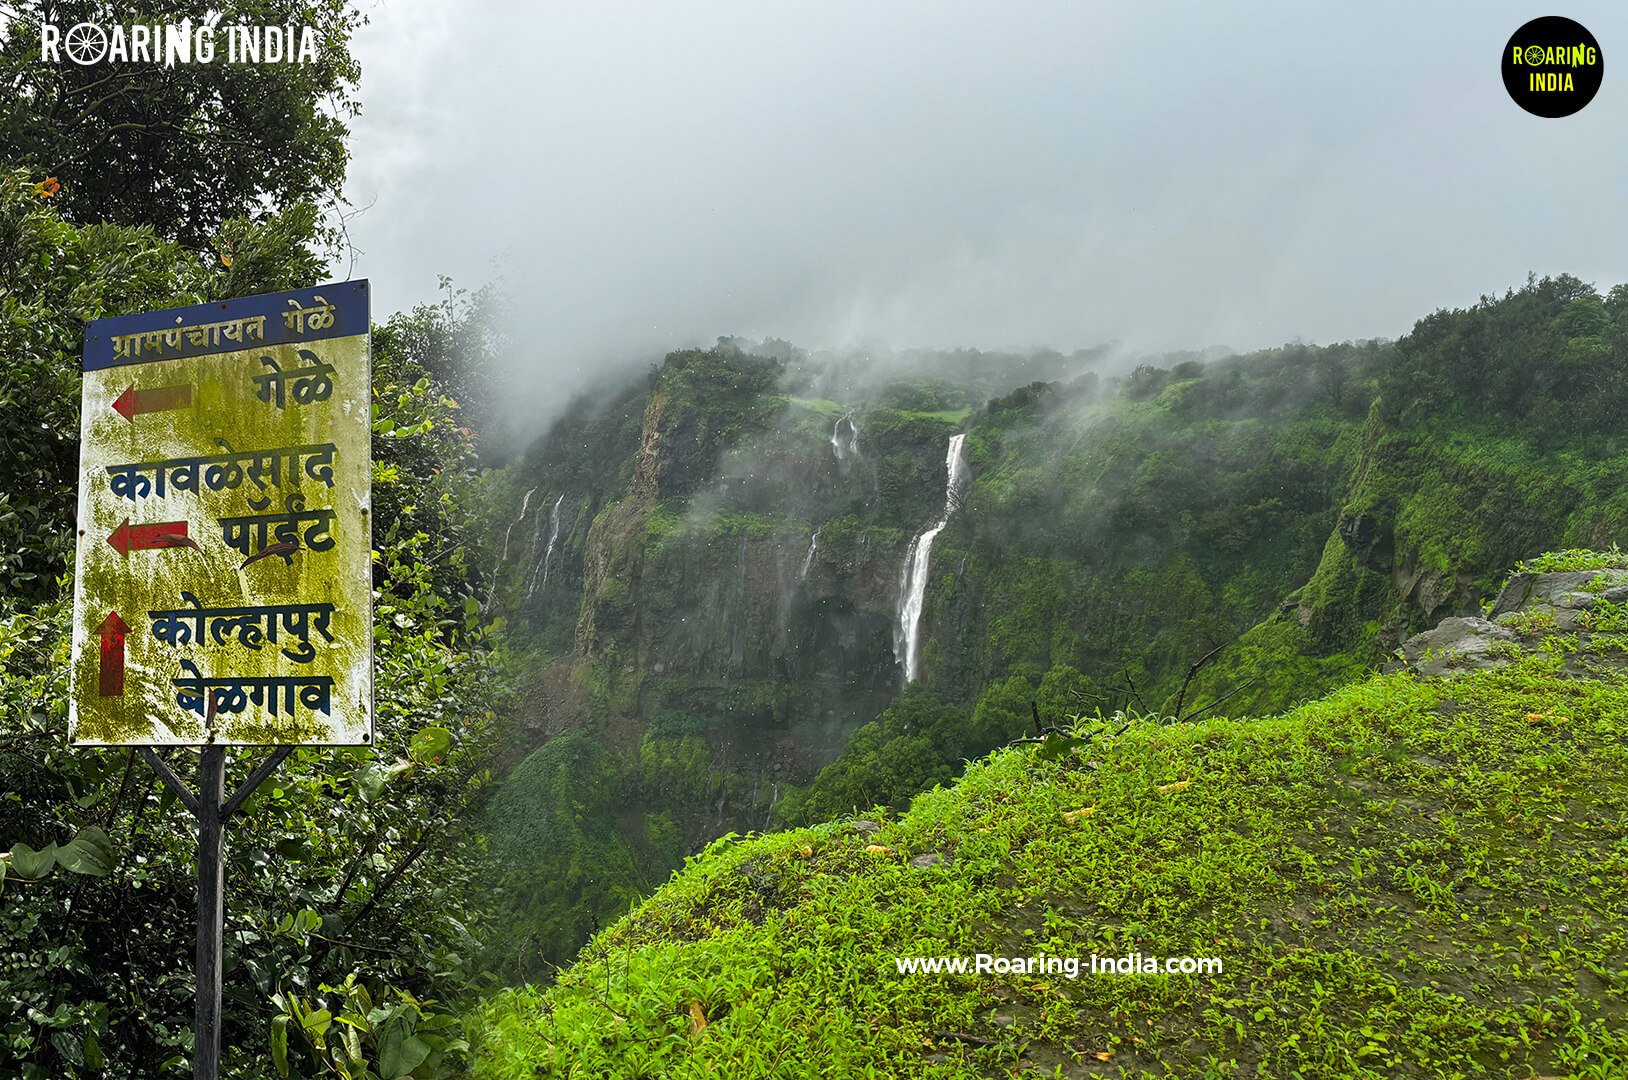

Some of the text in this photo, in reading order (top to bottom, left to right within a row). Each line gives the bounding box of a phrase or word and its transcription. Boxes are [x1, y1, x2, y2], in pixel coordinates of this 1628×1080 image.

[110, 295, 337, 361] ग्रामपंचायत गेळे
[251, 350, 338, 410] गेळे
[105, 437, 338, 501] कावळेसाद
[147, 591, 336, 663] कोल्हापुर
[172, 659, 336, 717] बेळगाव
